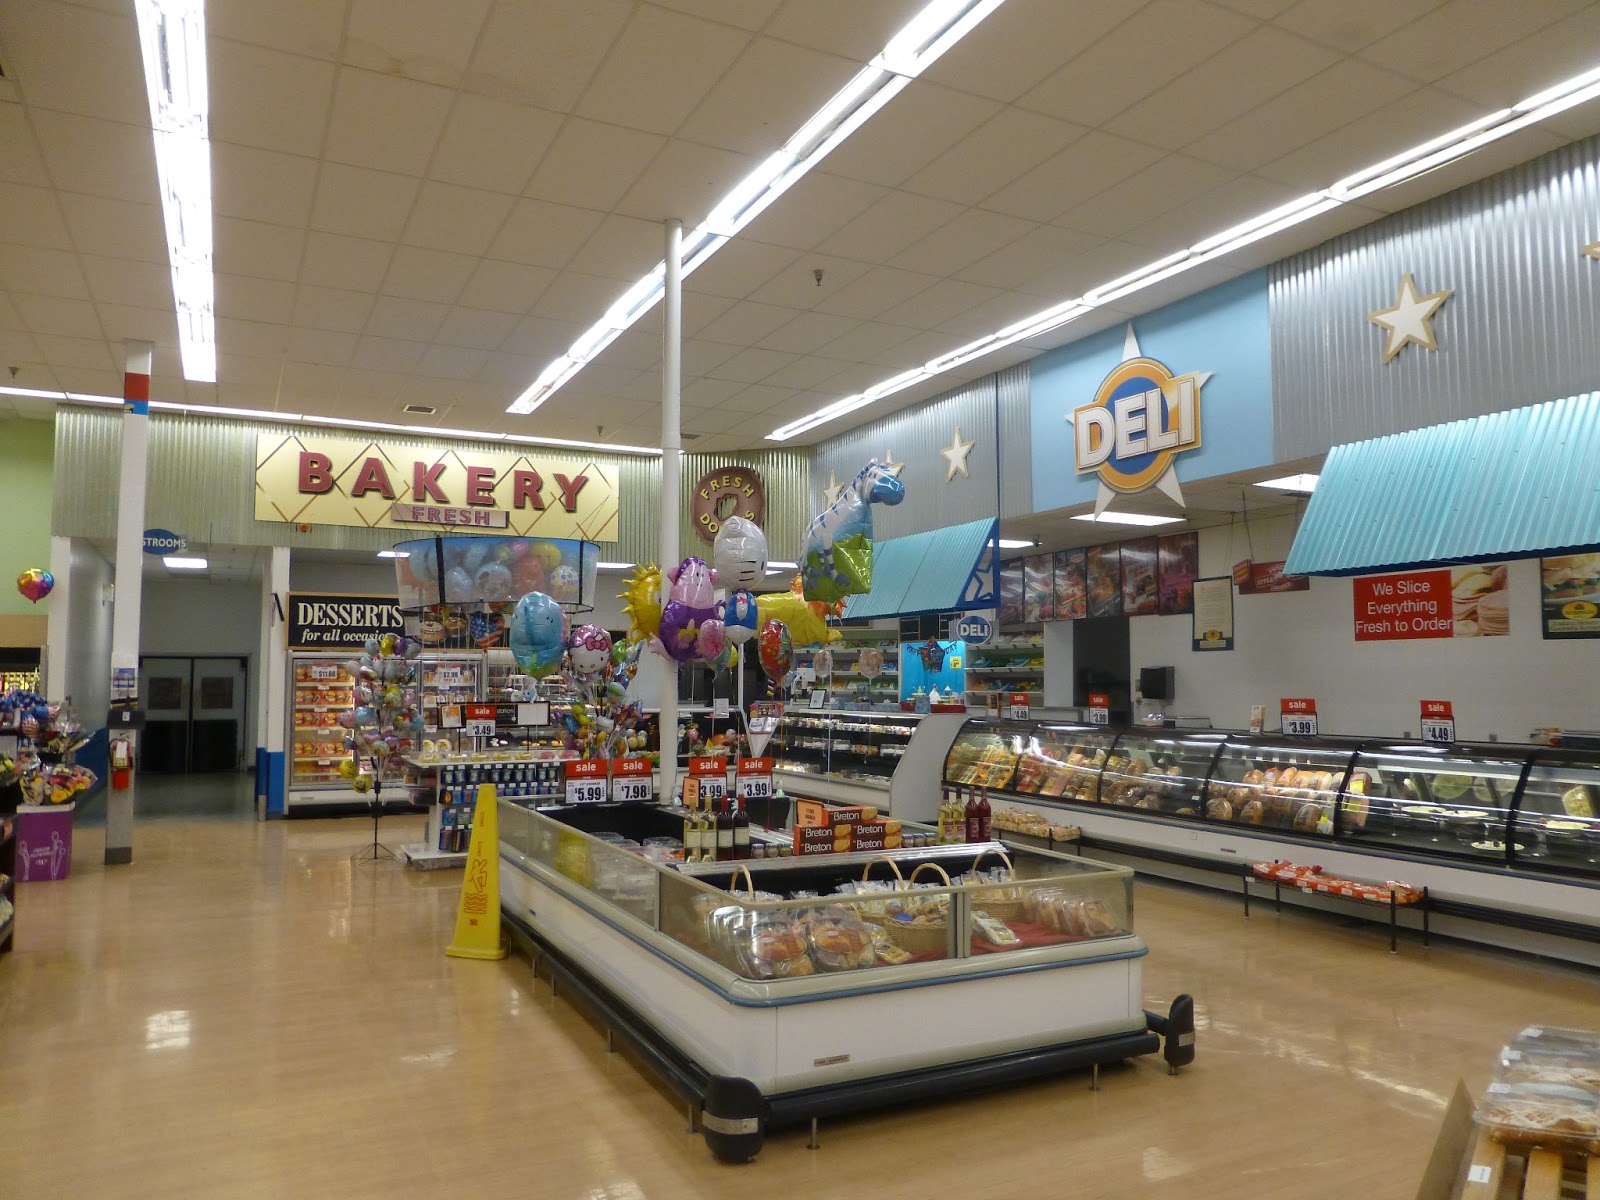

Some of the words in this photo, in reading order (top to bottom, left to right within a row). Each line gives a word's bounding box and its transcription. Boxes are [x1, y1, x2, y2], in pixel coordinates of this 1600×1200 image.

[1078, 377, 1195, 469] DELI
[298, 450, 589, 512] BAKERY
[700, 475, 755, 500] FRESH
[410, 504, 491, 526] FRESH
[700, 509, 756, 533] DOS
[142, 537, 187, 548] STROOMS
[1372, 583, 1394, 596] We
[1396, 580, 1431, 594] Slice
[1367, 599, 1437, 616] Everything
[297, 602, 404, 628] DESSERTS
[960, 623, 989, 637] DELI
[1355, 620, 1391, 634] Fresh
[1395, 620, 1409, 632] to
[1412, 617, 1453, 631] Order
[301, 628, 321, 644] for
[322, 628, 341, 641] all
[342, 630, 386, 642] occasio
[475, 707, 490, 715] sale
[1288, 700, 1307, 709] sale
[1428, 702, 1445, 712] sale
[472, 725, 491, 735] $3.49
[1289, 721, 1311, 734] $3.99
[1428, 726, 1449, 741] $4.49
[575, 762, 597, 772] sale
[623, 760, 643, 770] sale
[699, 760, 718, 770] sale
[744, 759, 763, 769] sale
[574, 787, 601, 801] $5.99
[621, 784, 647, 799] $7.98
[743, 782, 768, 797] $3.99
[833, 812, 860, 821] Breton
[805, 828, 832, 838] Breton
[857, 825, 883, 835] Breton
[804, 842, 832, 853] Breton
[856, 839, 882, 849] Breton
